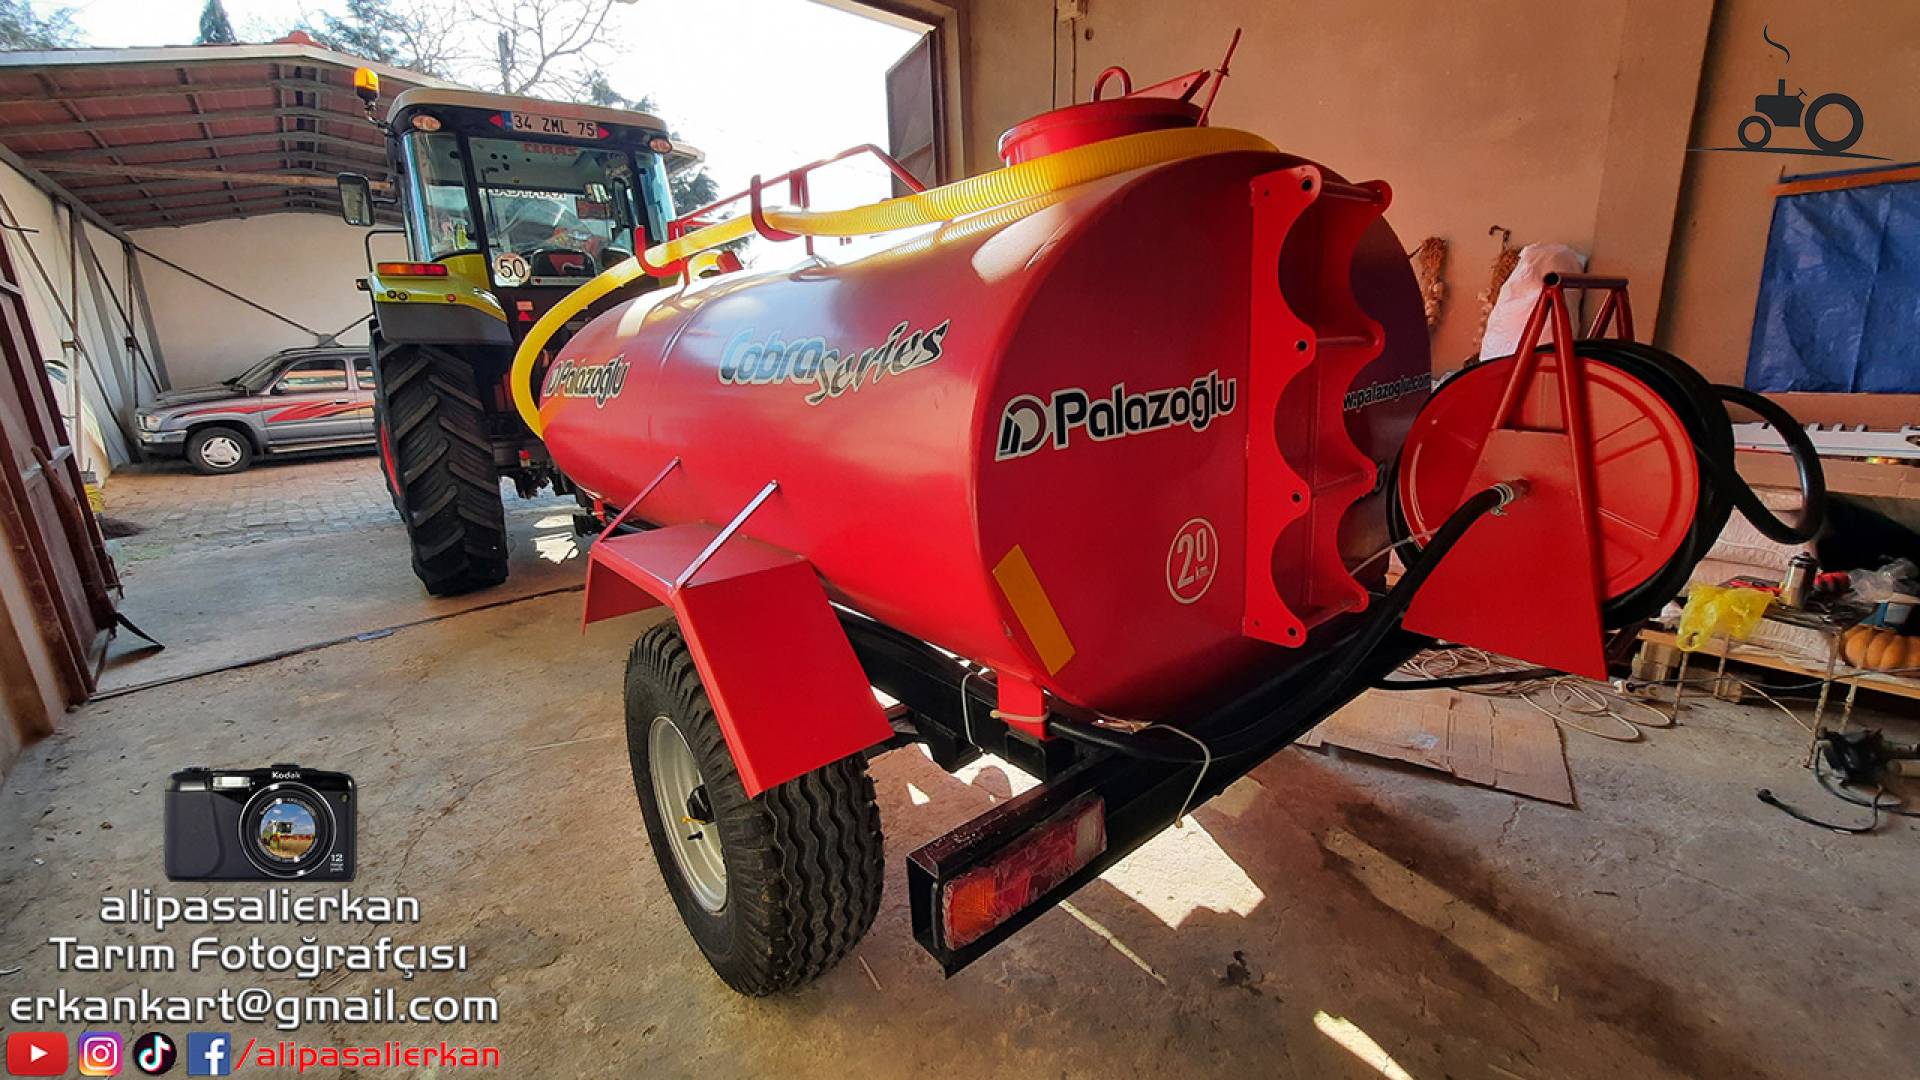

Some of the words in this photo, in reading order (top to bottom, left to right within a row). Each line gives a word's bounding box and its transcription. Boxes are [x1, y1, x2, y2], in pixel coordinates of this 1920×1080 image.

[513, 115, 532, 129] 34
[542, 118, 569, 134] ZML
[577, 122, 595, 137] 75
[500, 259, 526, 278] 50
[719, 328, 826, 384] Cobra
[1055, 370, 1236, 450] Palazoğlu
[1177, 527, 1207, 589] 20
